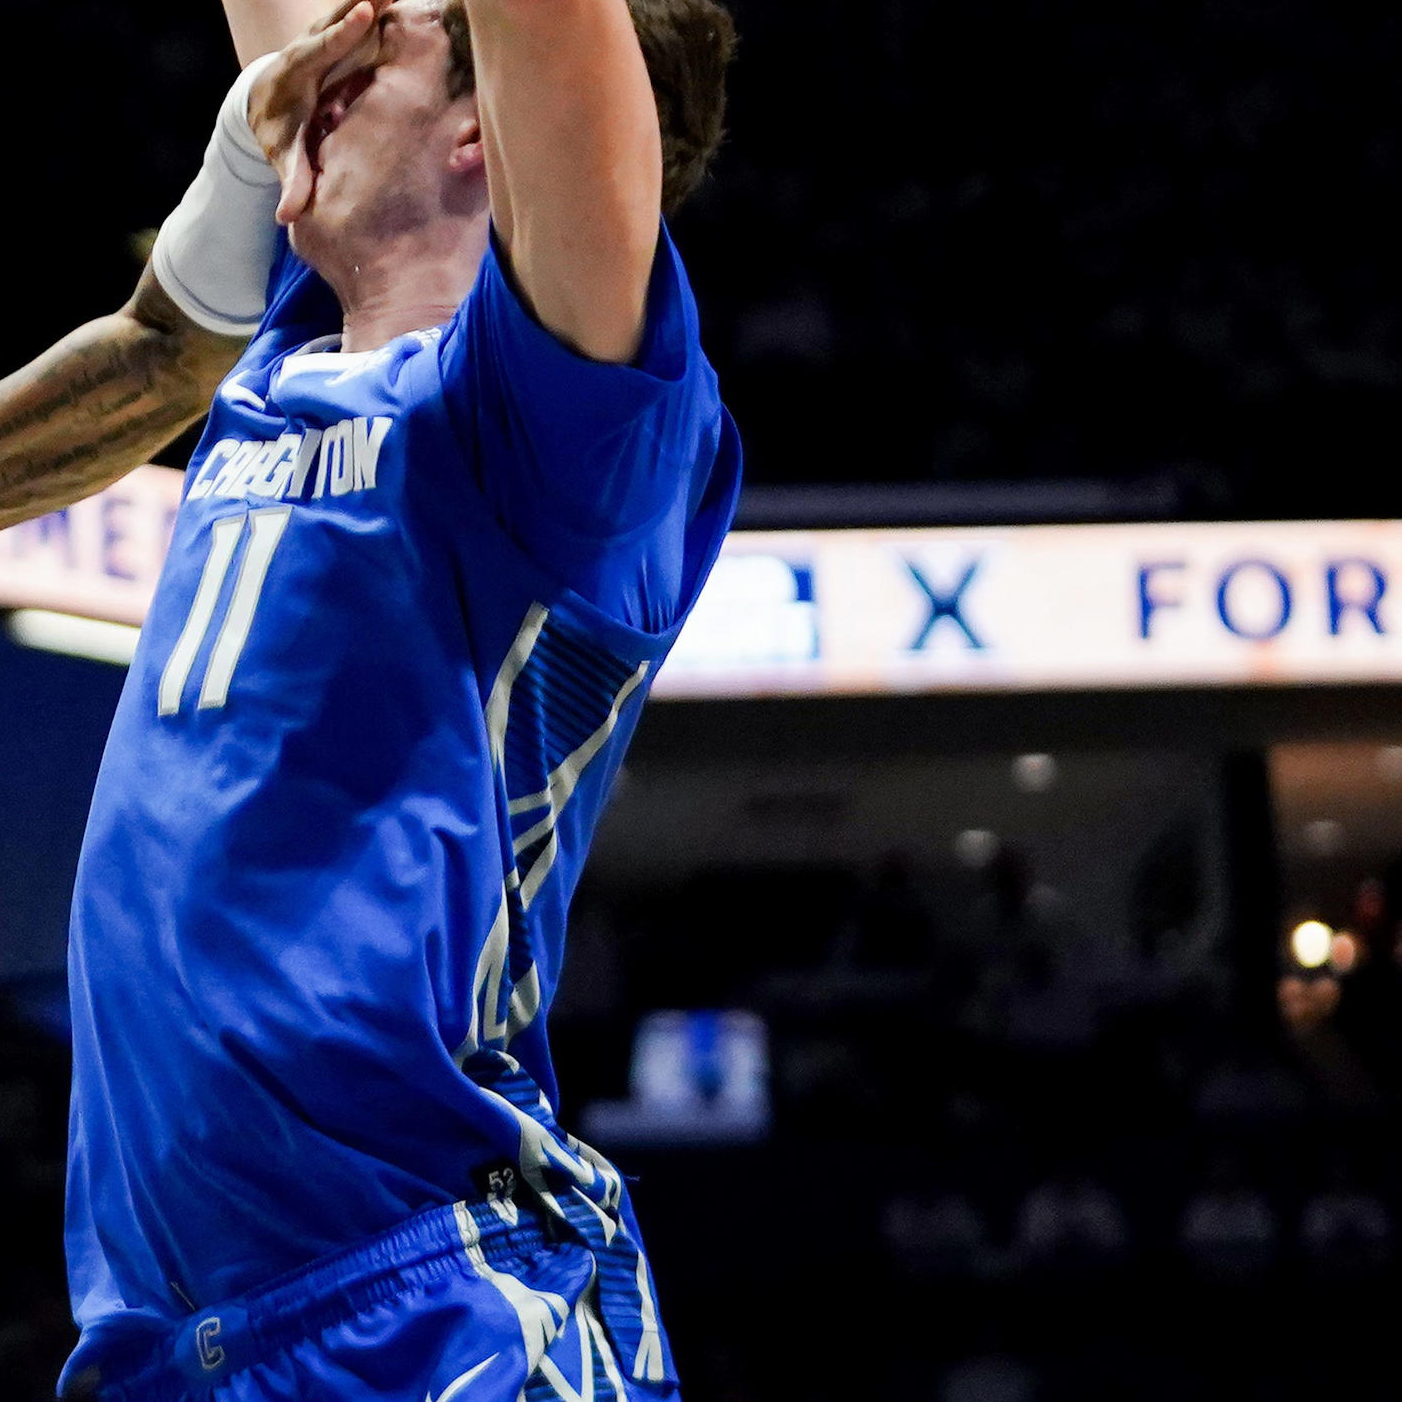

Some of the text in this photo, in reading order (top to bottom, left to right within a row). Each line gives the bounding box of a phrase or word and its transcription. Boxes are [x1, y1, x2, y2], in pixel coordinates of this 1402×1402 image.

[157, 504, 294, 717] 11
[901, 553, 991, 653] X
[1135, 553, 1386, 642] FOR
[196, 1316, 225, 1371] C
